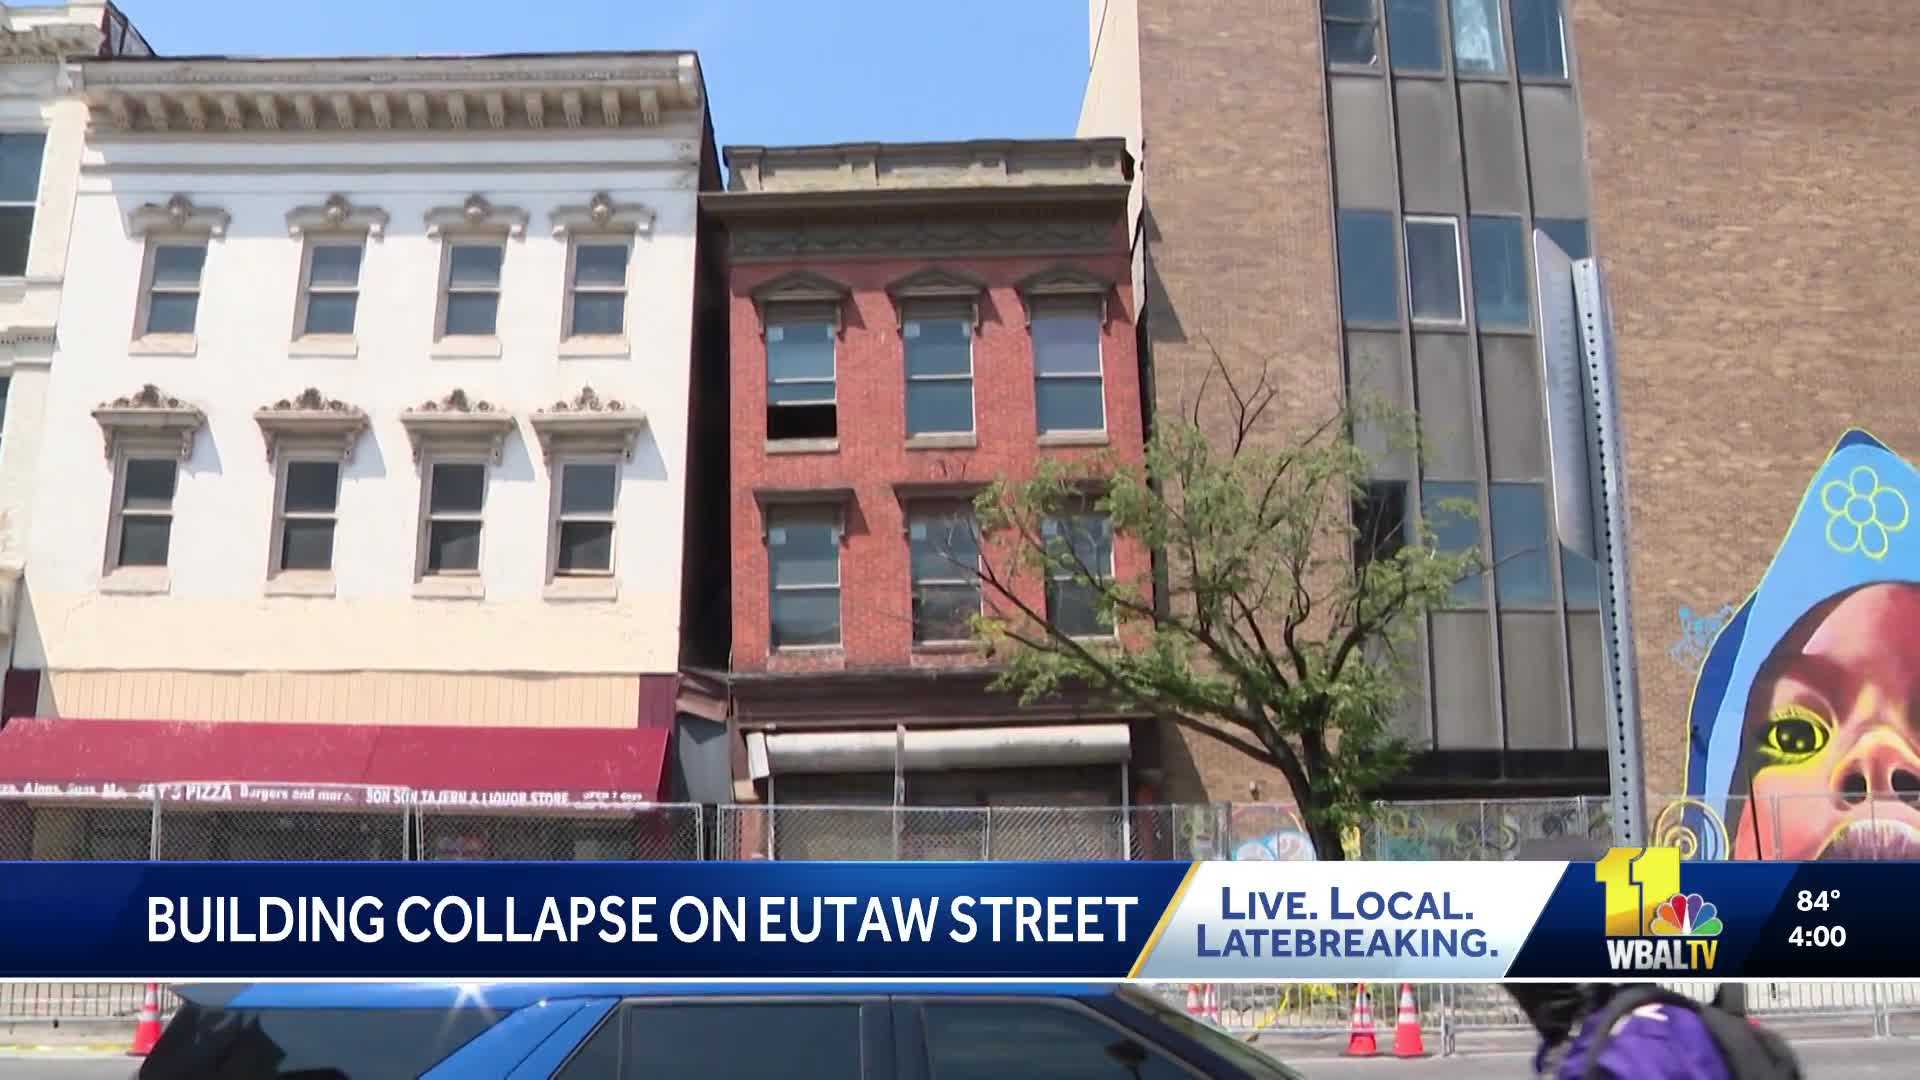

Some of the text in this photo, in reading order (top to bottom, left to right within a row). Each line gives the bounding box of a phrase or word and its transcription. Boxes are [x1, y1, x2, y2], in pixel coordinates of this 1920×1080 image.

[186, 783, 232, 800] PIZZA
[292, 789, 315, 800] and
[530, 791, 569, 806] STORE
